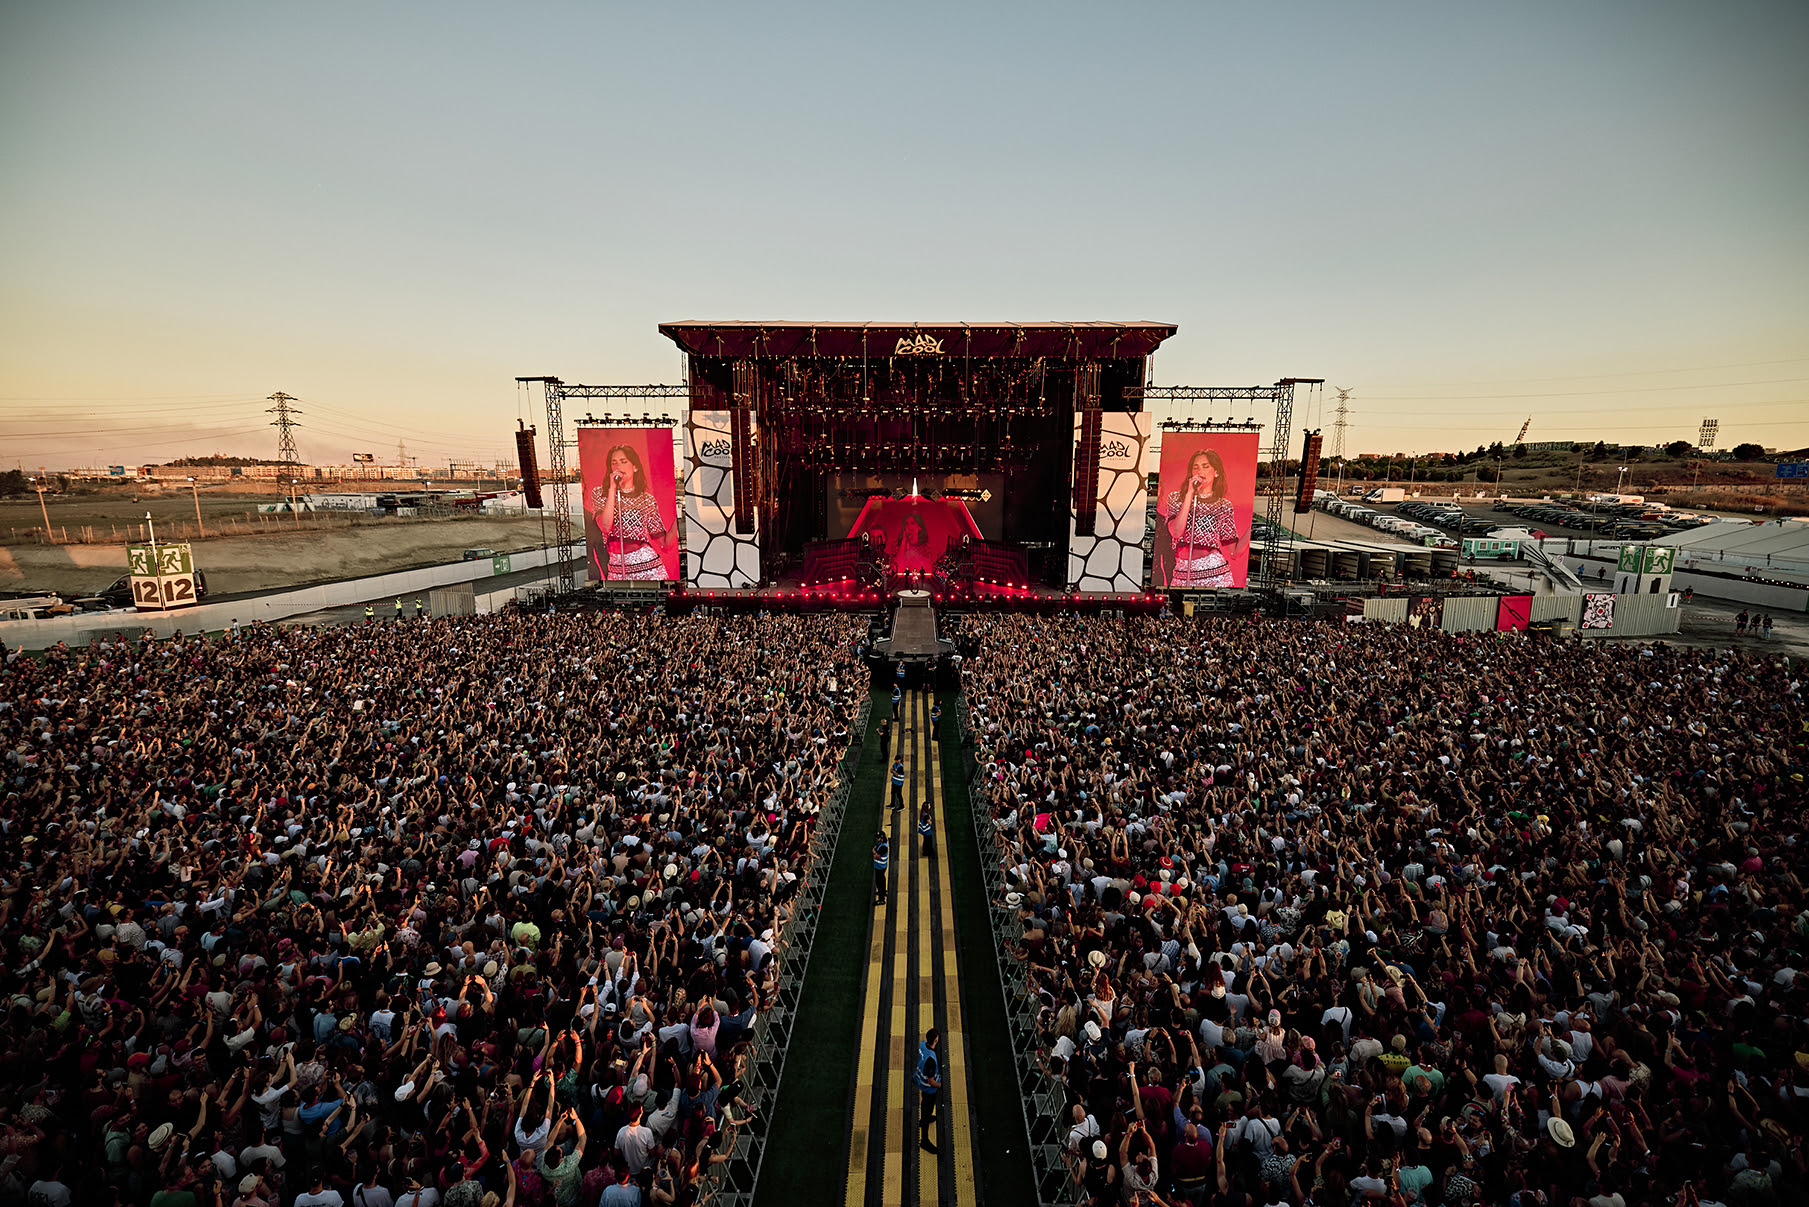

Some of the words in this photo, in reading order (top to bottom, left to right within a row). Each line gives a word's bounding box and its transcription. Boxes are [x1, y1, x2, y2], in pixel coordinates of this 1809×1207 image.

[894, 334, 937, 355] MAD
[897, 338, 946, 355] COOL
[703, 448, 730, 457] COO
[133, 581, 160, 602] 12
[164, 578, 194, 602] 12
